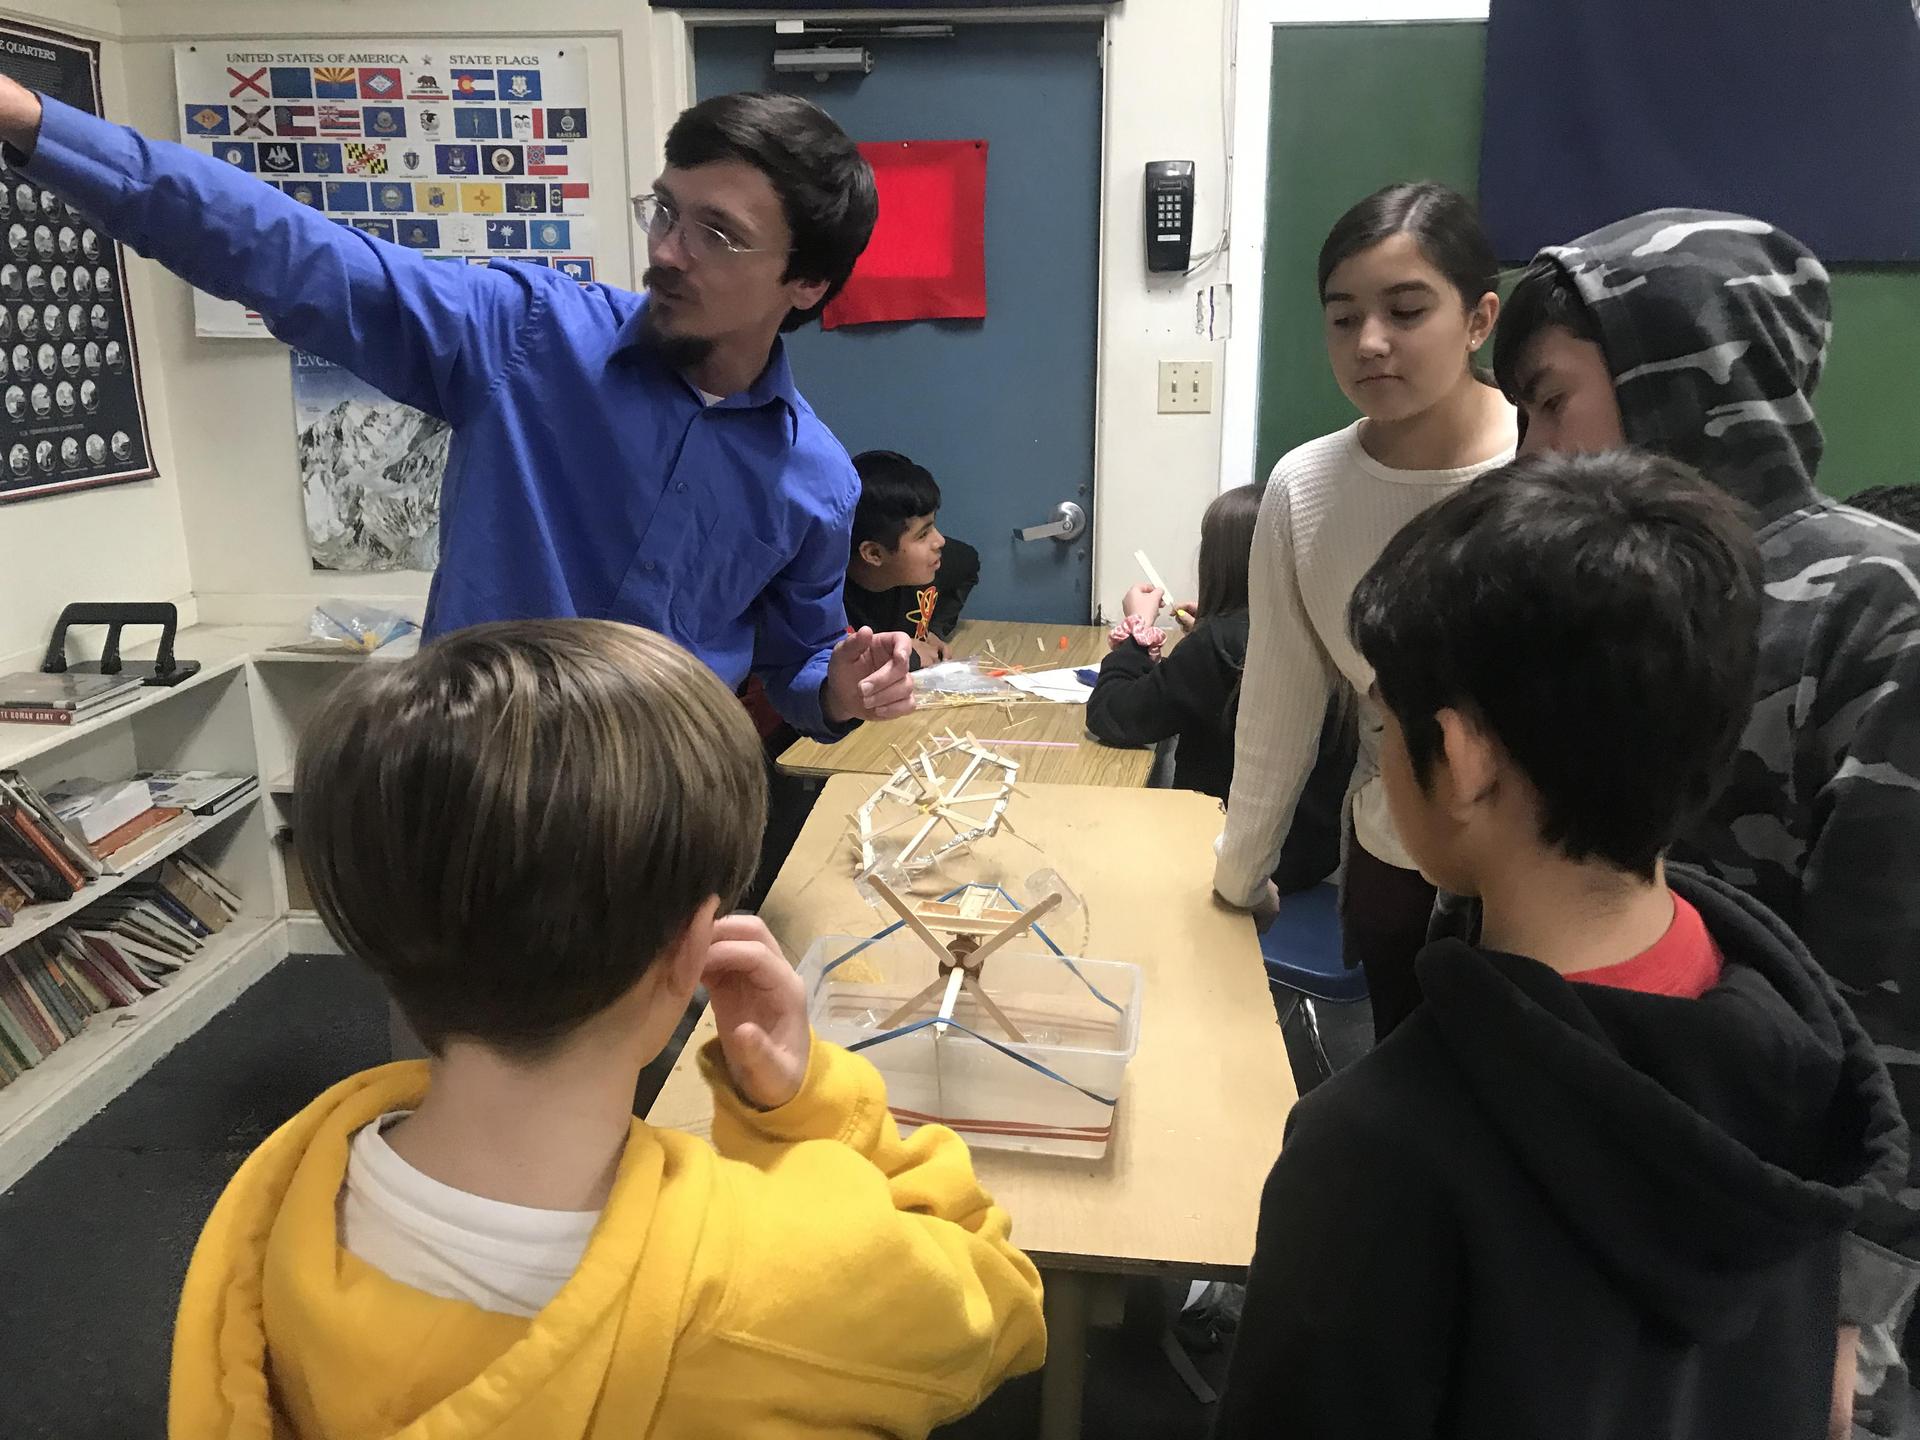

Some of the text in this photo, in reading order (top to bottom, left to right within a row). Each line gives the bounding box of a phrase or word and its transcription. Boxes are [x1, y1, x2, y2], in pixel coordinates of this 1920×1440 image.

[6, 41, 56, 61] QUARTERS
[226, 53, 409, 64] UNITED STATES OF AMERICA
[449, 55, 539, 65] STATE FLAGS
[10, 711, 33, 720] ROMAN
[35, 712, 54, 721] ARMY
